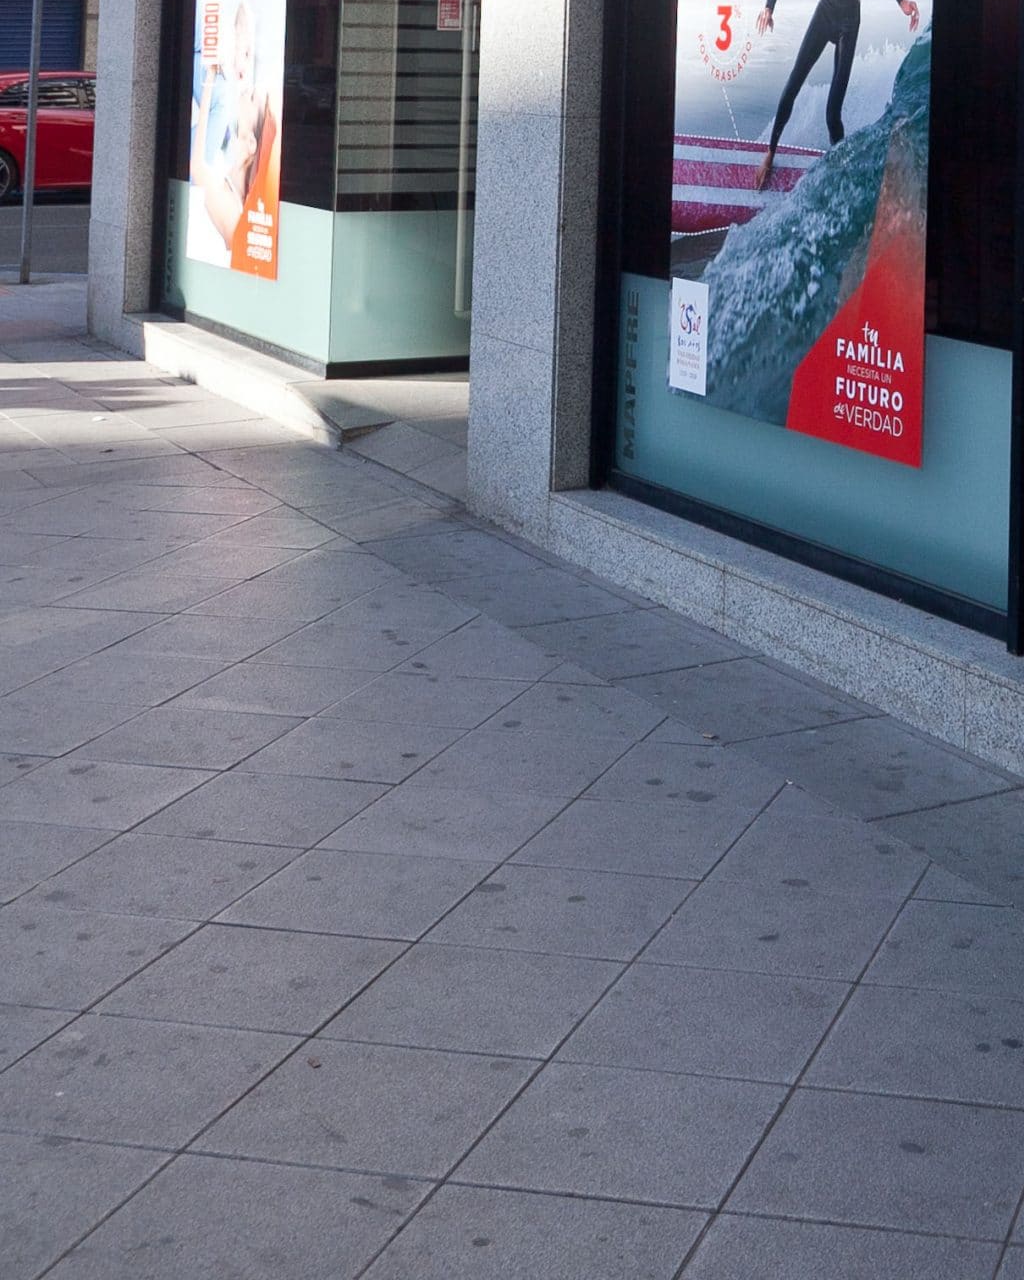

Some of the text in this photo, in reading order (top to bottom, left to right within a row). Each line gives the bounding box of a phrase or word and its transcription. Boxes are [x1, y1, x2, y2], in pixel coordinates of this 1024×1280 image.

[862, 321, 879, 347] tu
[836, 338, 904, 373] FAMILIA
[622, 288, 640, 460] MAPFRE
[847, 364, 892, 384] NECESITA UN
[835, 376, 903, 412] FUTURO
[845, 404, 903, 437] VERDAD
